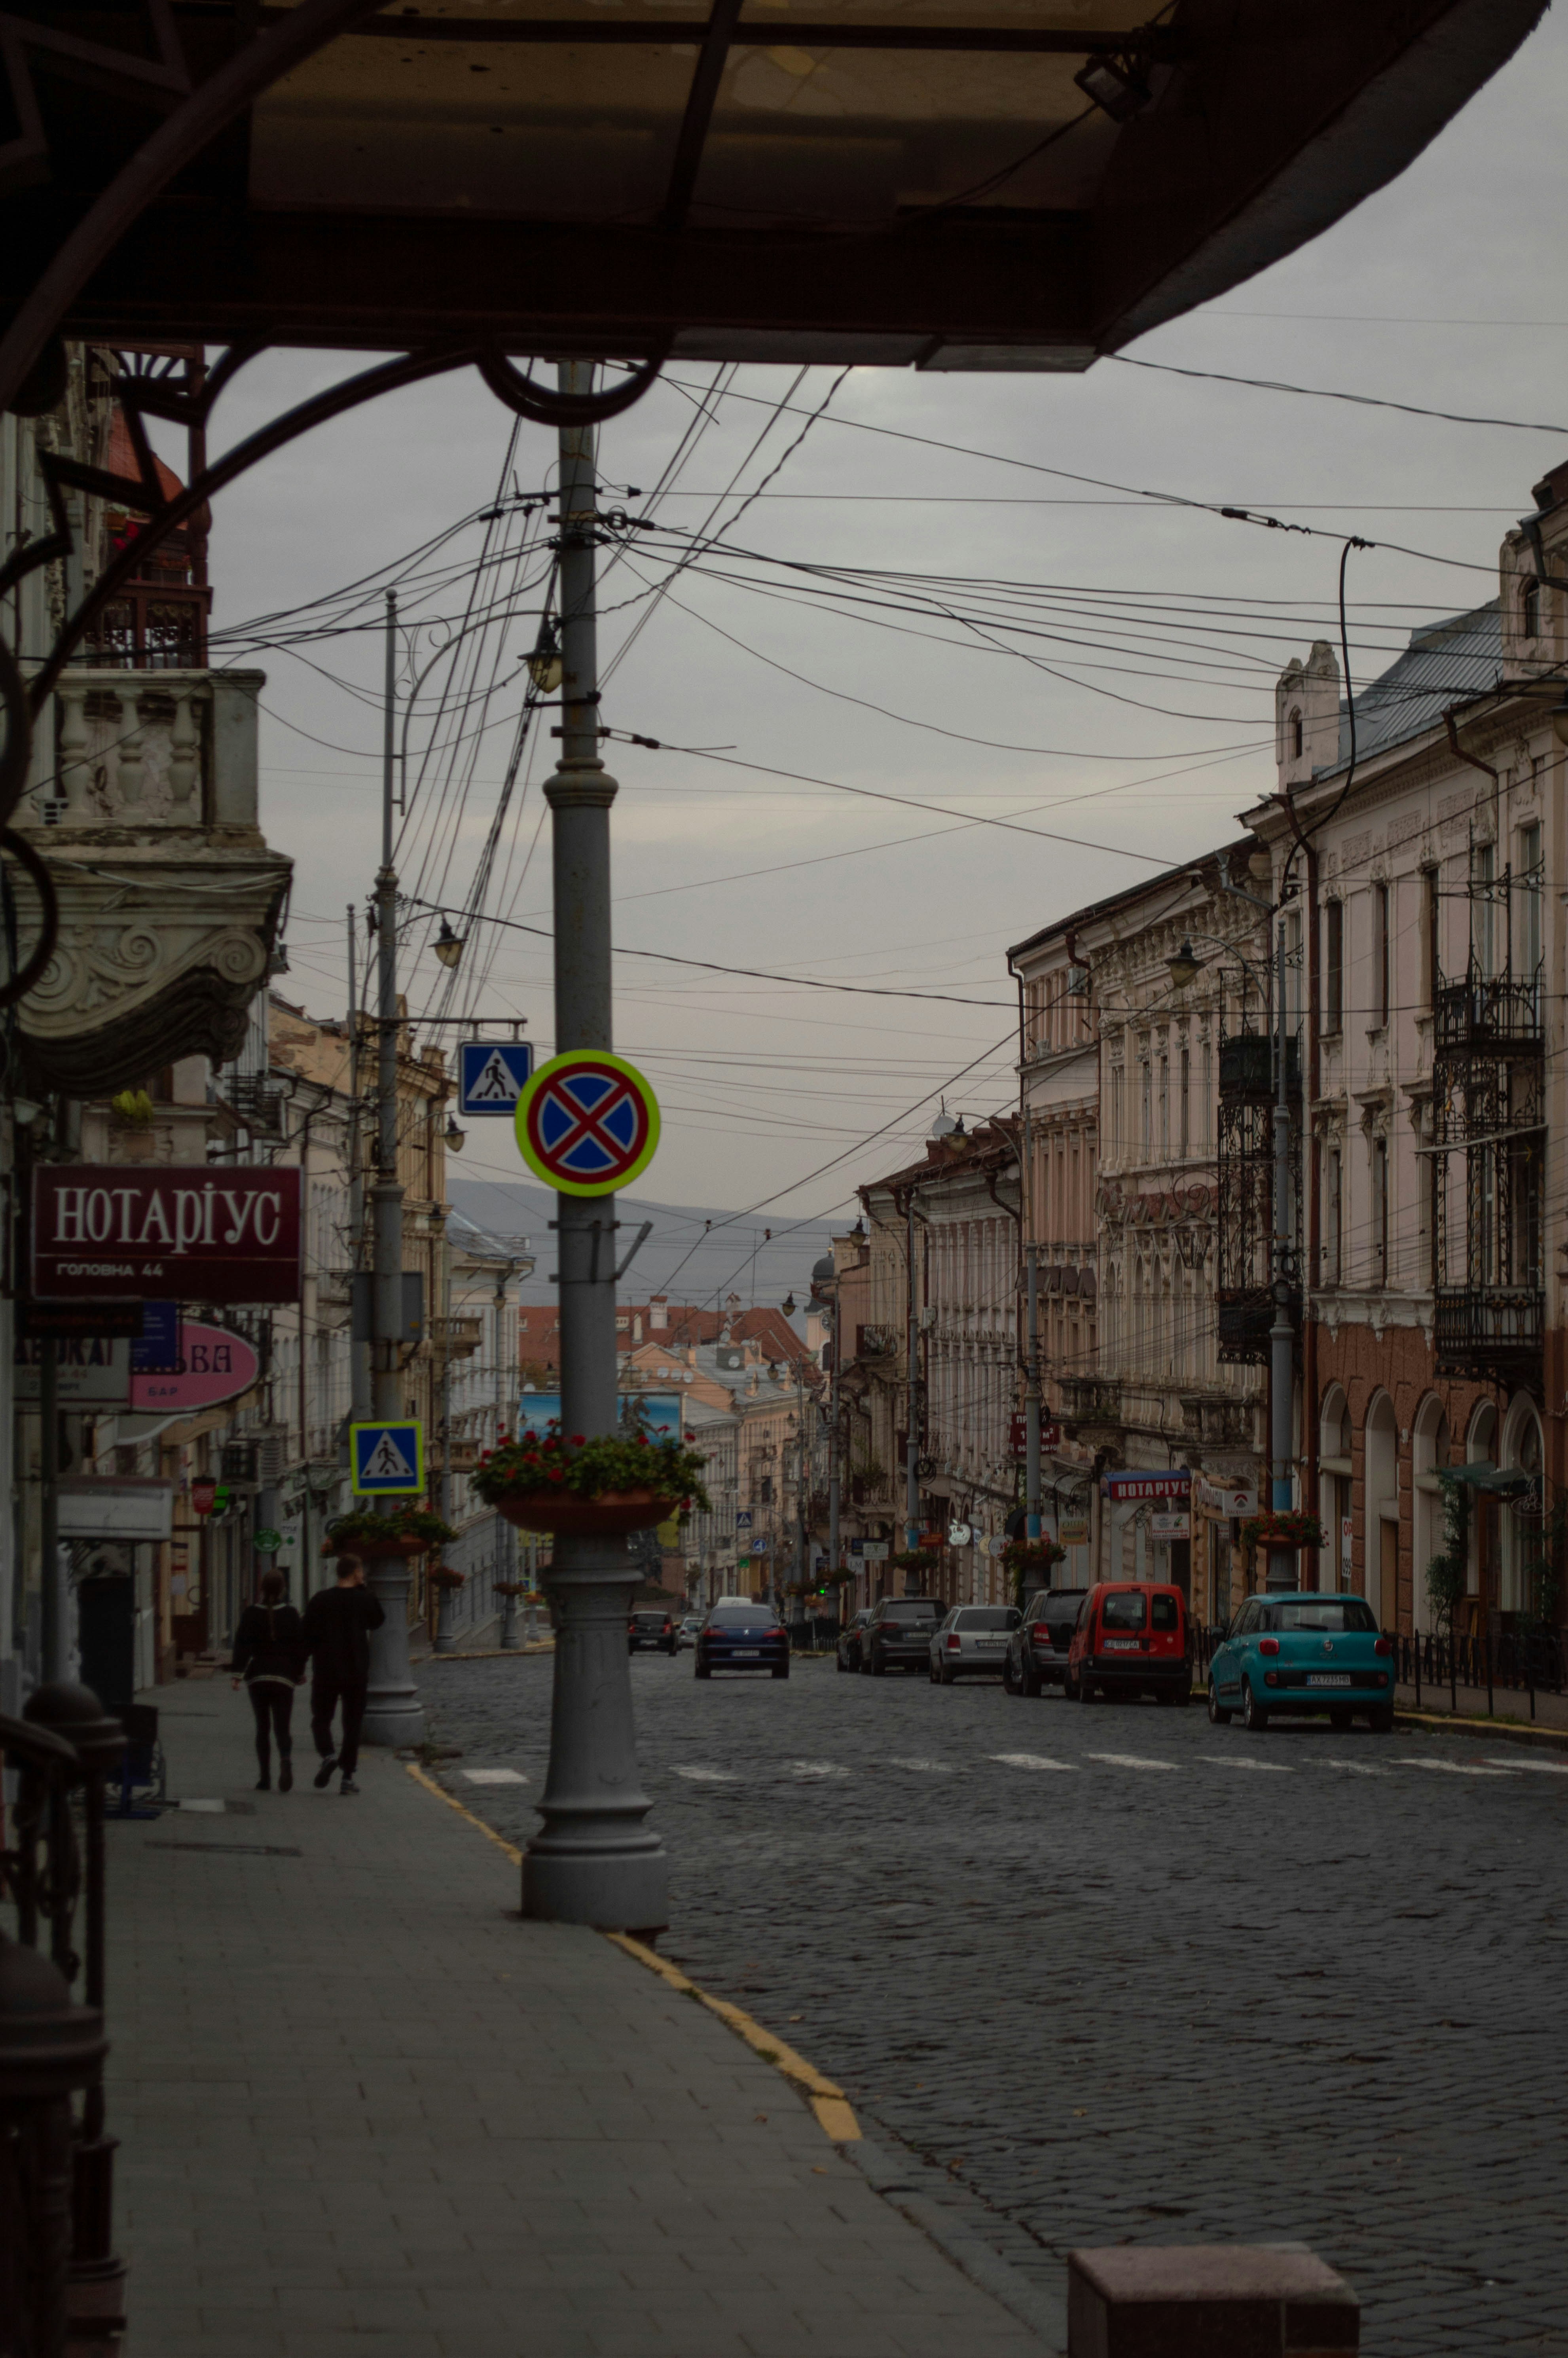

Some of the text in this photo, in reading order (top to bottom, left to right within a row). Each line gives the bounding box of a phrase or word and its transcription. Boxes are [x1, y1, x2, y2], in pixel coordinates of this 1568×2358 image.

[56, 1262, 164, 1277] ГОЛОВНА 44
[148, 1387, 178, 1397] БАР
[1118, 1481, 1189, 1497] НОТАРІУС
